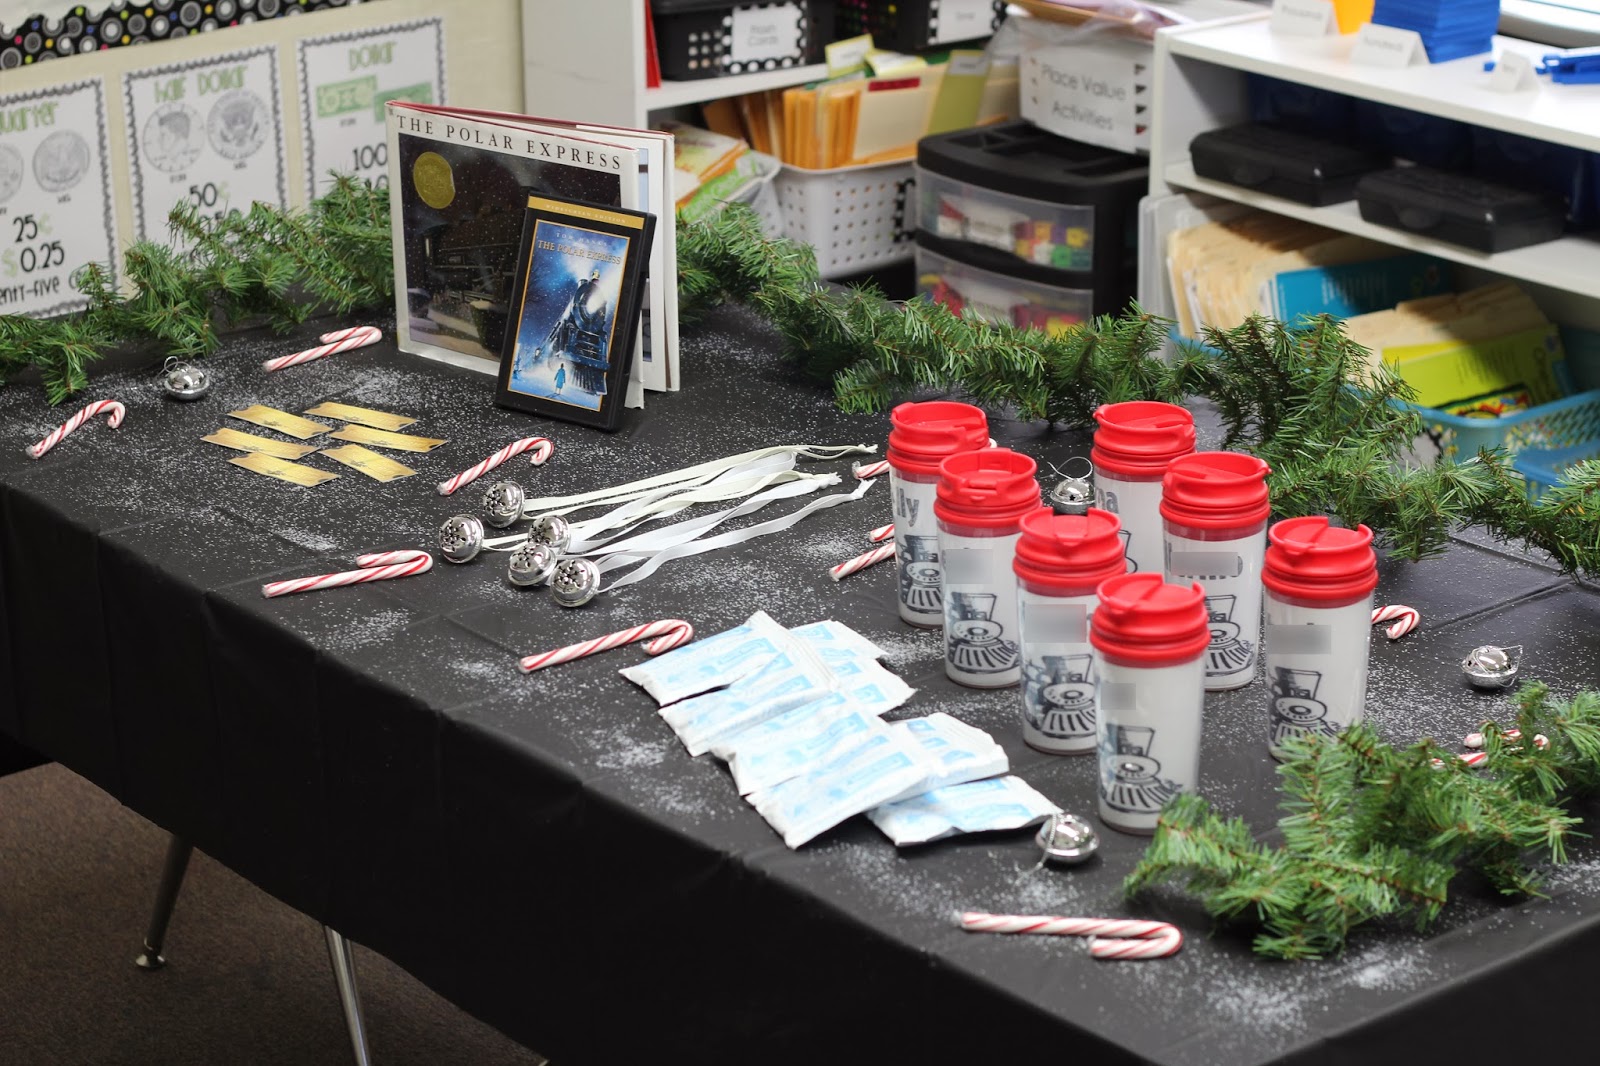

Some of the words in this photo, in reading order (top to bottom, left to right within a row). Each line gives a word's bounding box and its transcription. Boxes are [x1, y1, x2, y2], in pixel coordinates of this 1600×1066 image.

[1081, 75, 1127, 101] Value
[1051, 100, 1114, 131] Activities
[397, 115, 434, 135] THE
[446, 124, 514, 150] POLAR
[526, 139, 621, 170] EXPRESS
[538, 239, 556, 252] THE
[557, 243, 586, 259] POLAR
[586, 250, 622, 266] EXPRESS
